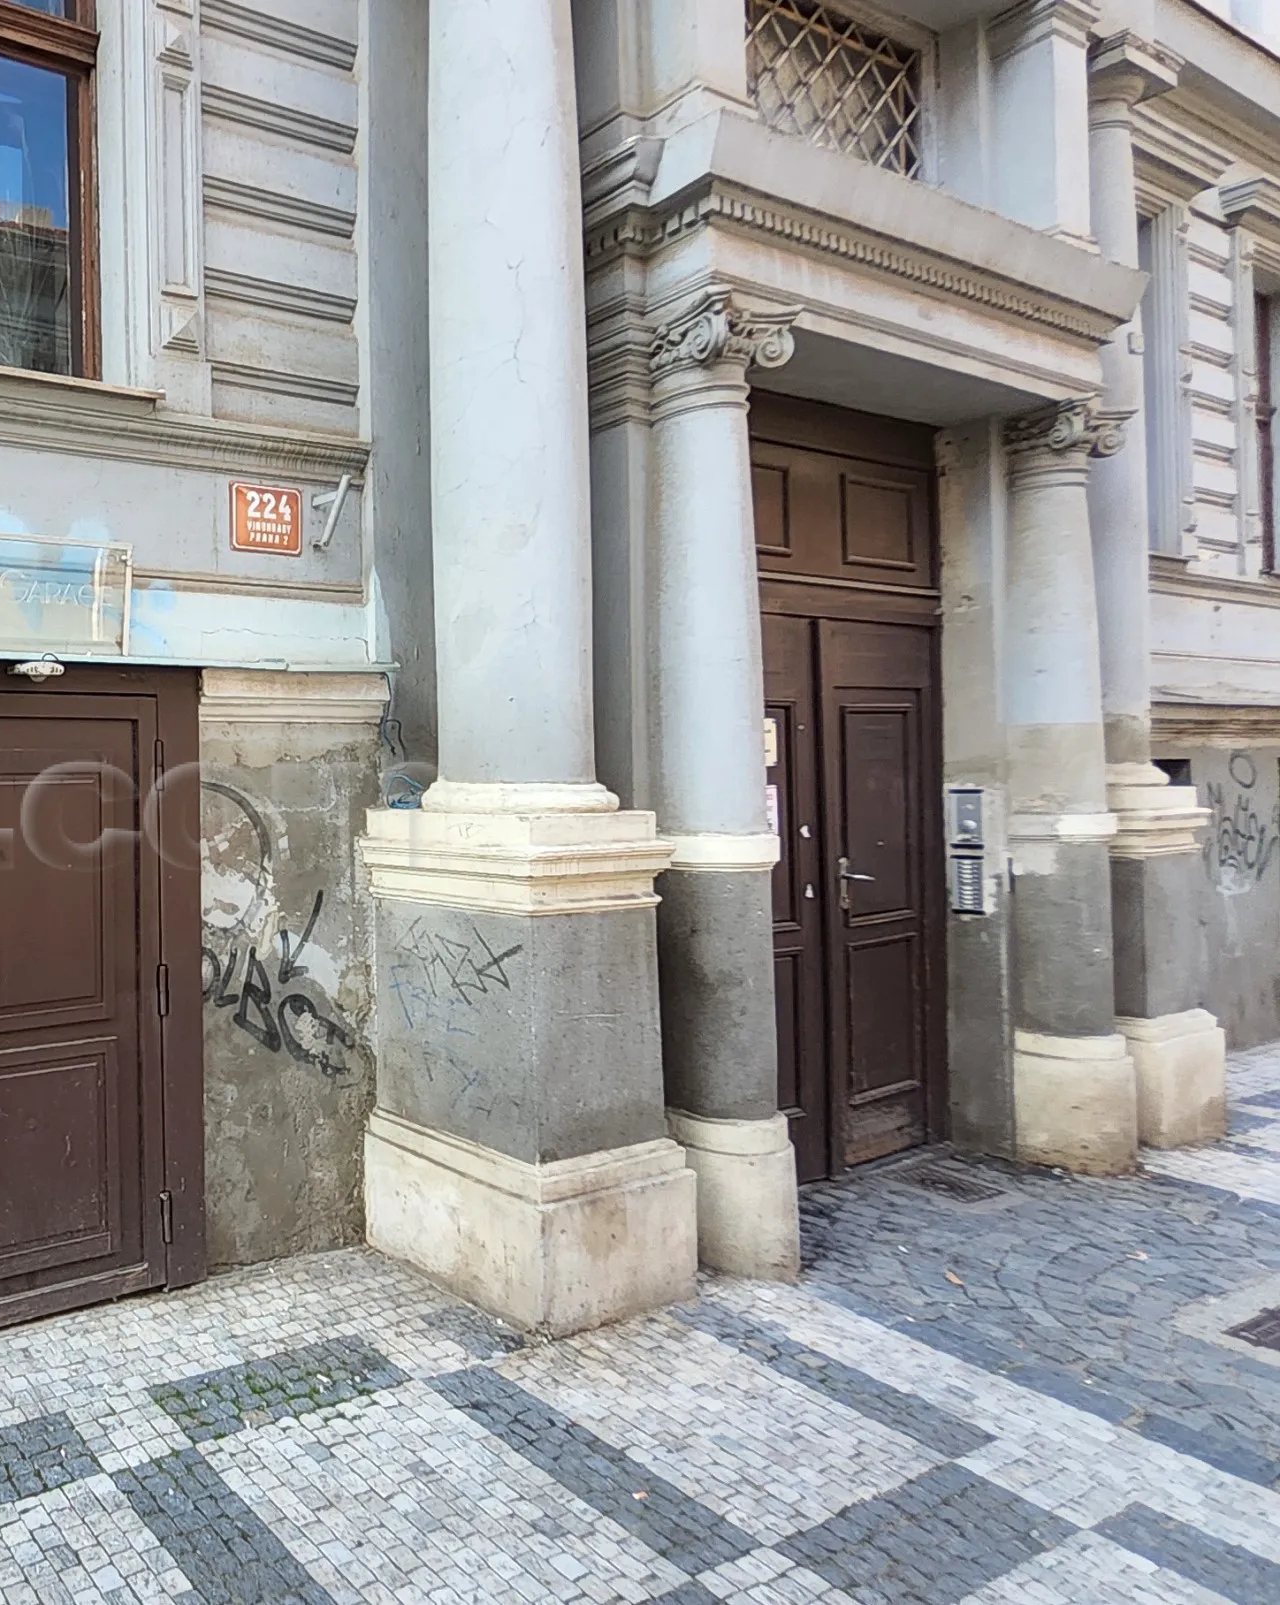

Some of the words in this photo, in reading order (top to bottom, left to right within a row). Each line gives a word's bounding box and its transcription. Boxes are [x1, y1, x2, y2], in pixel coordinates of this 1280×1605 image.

[246, 491, 292, 521] 224
[249, 532, 280, 544] PRAHA
[282, 535, 289, 545] 2
